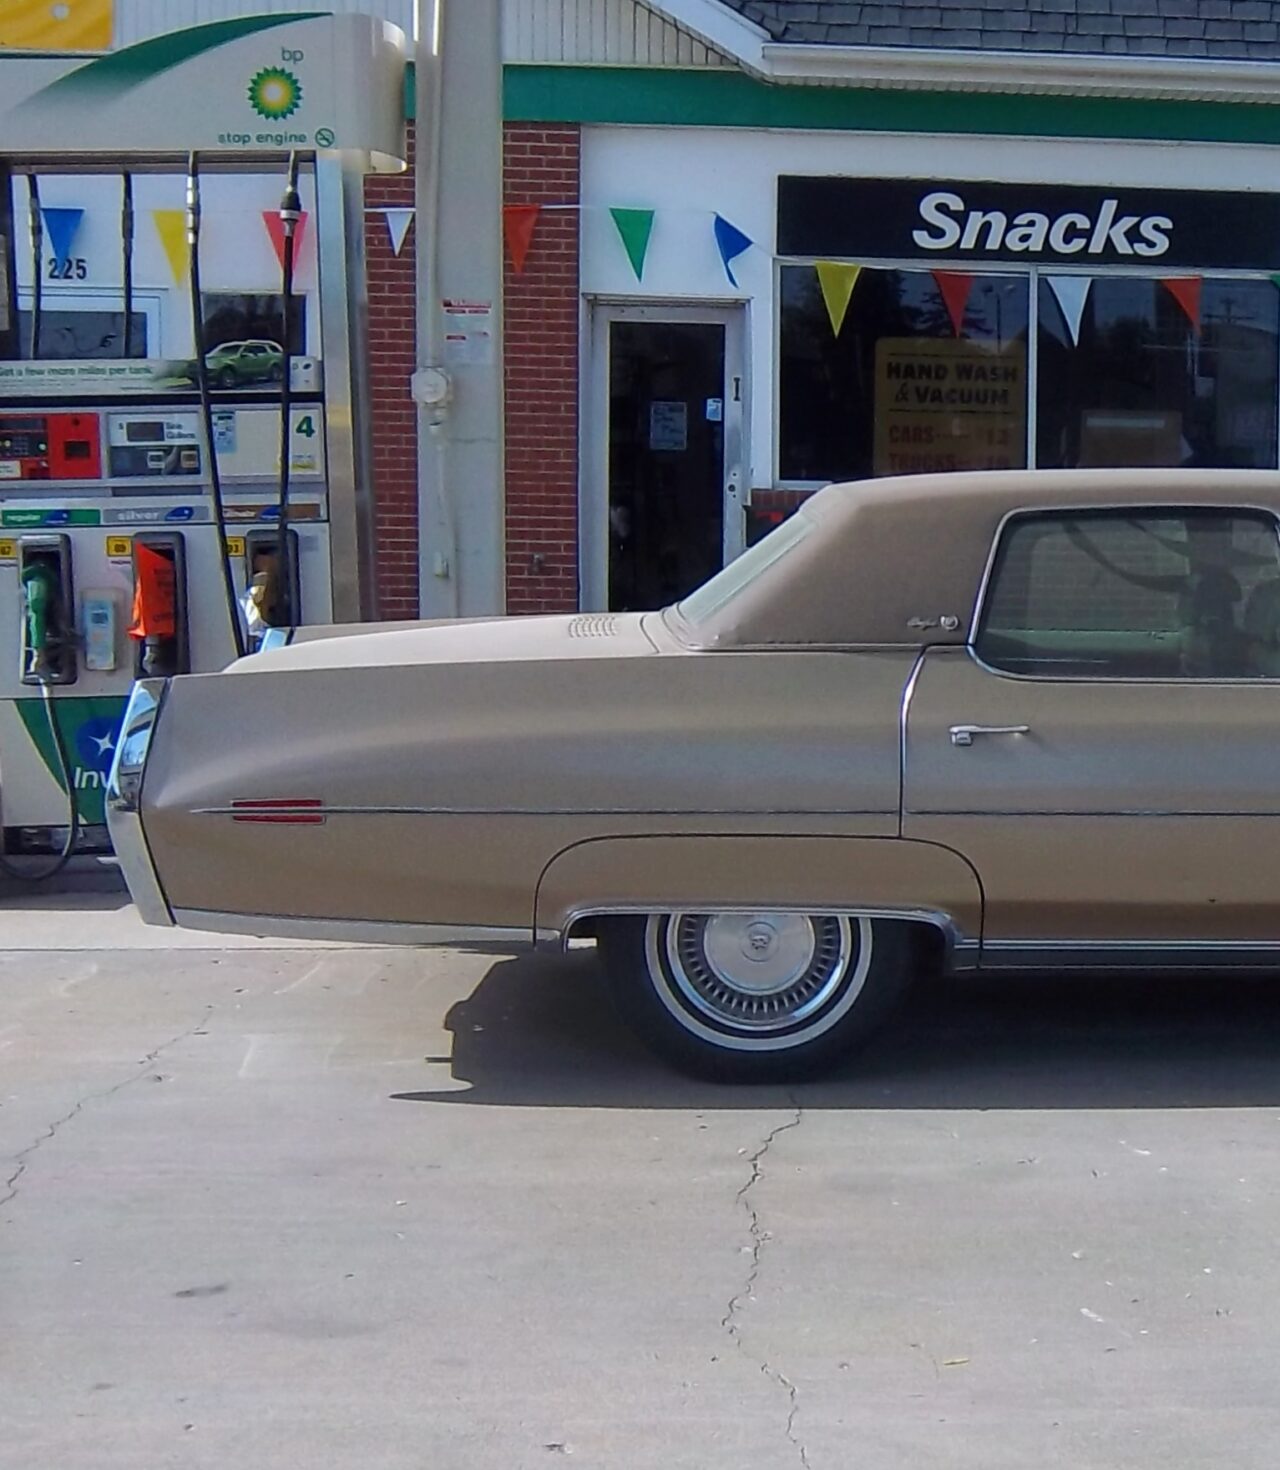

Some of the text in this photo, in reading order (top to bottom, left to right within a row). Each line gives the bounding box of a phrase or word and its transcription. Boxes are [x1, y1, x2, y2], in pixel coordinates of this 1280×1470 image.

[281, 47, 304, 64] bp
[218, 131, 307, 146] stop engine
[912, 192, 1174, 257] Snacks
[48, 257, 87, 280] 225
[887, 362, 1018, 383] HAND WASH
[914, 386, 1010, 406] VACUUM
[296, 416, 315, 437] 4
[118, 510, 159, 520] silver
